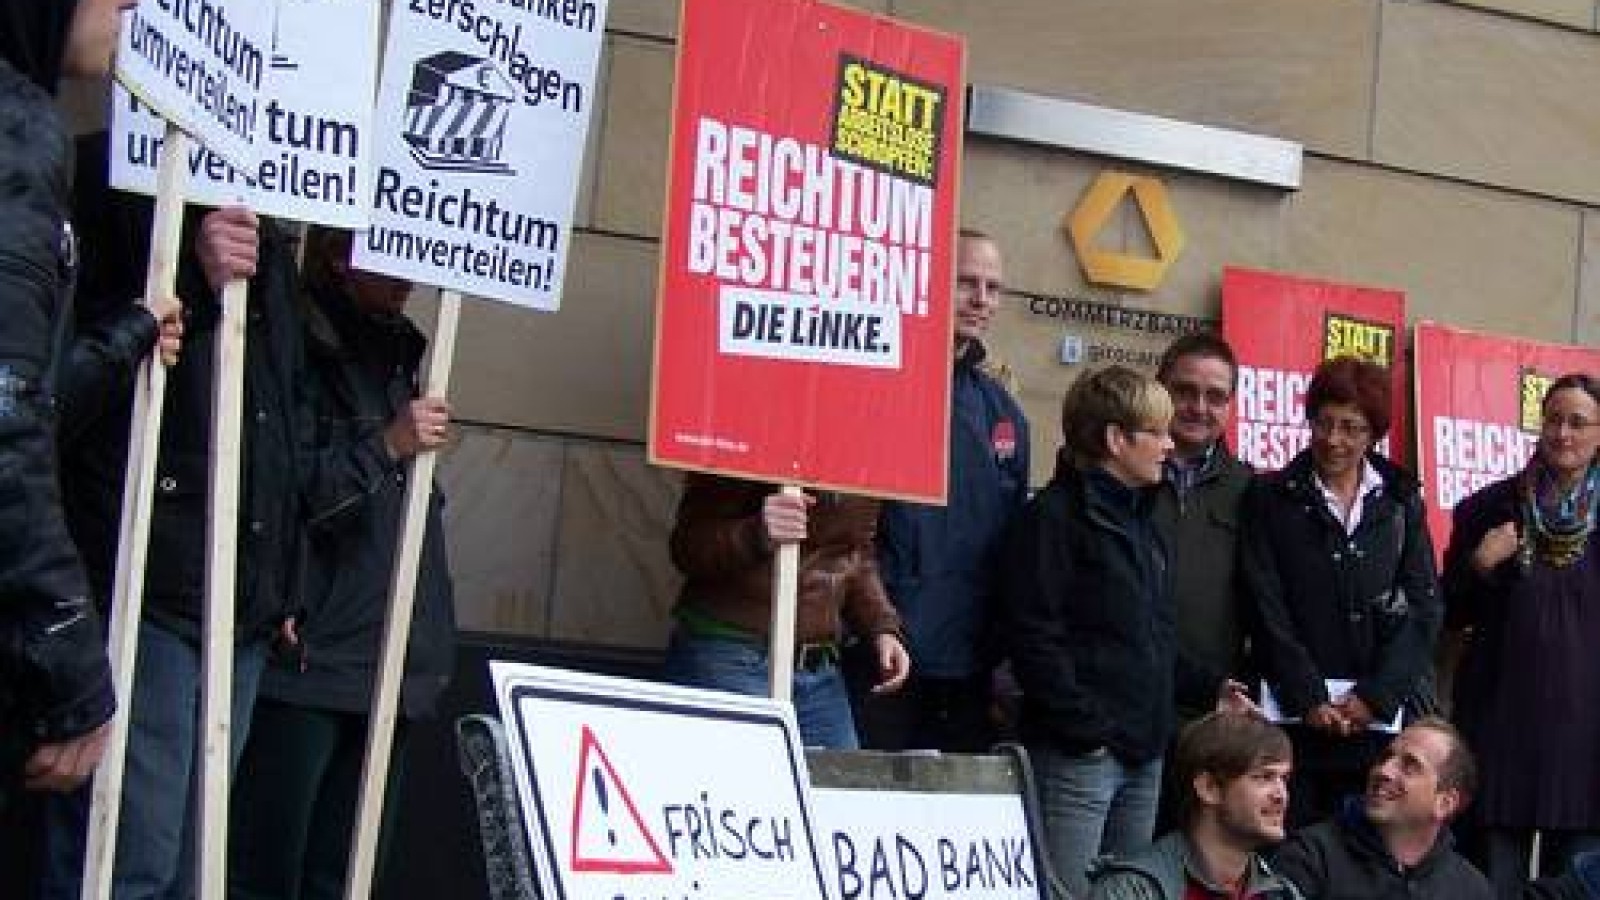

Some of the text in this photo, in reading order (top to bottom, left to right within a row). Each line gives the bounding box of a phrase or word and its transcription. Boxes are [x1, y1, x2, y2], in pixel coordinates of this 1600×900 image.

[841, 63, 941, 129] STATT
[373, 166, 560, 250] Reichtum
[693, 116, 935, 248] REICHTUM
[367, 224, 555, 292] umverteilen!
[687, 201, 932, 317] BESTEUERN!
[732, 300, 786, 344] DIE
[1326, 316, 1393, 362] STATT
[832, 832, 1034, 900] BAD BANK
